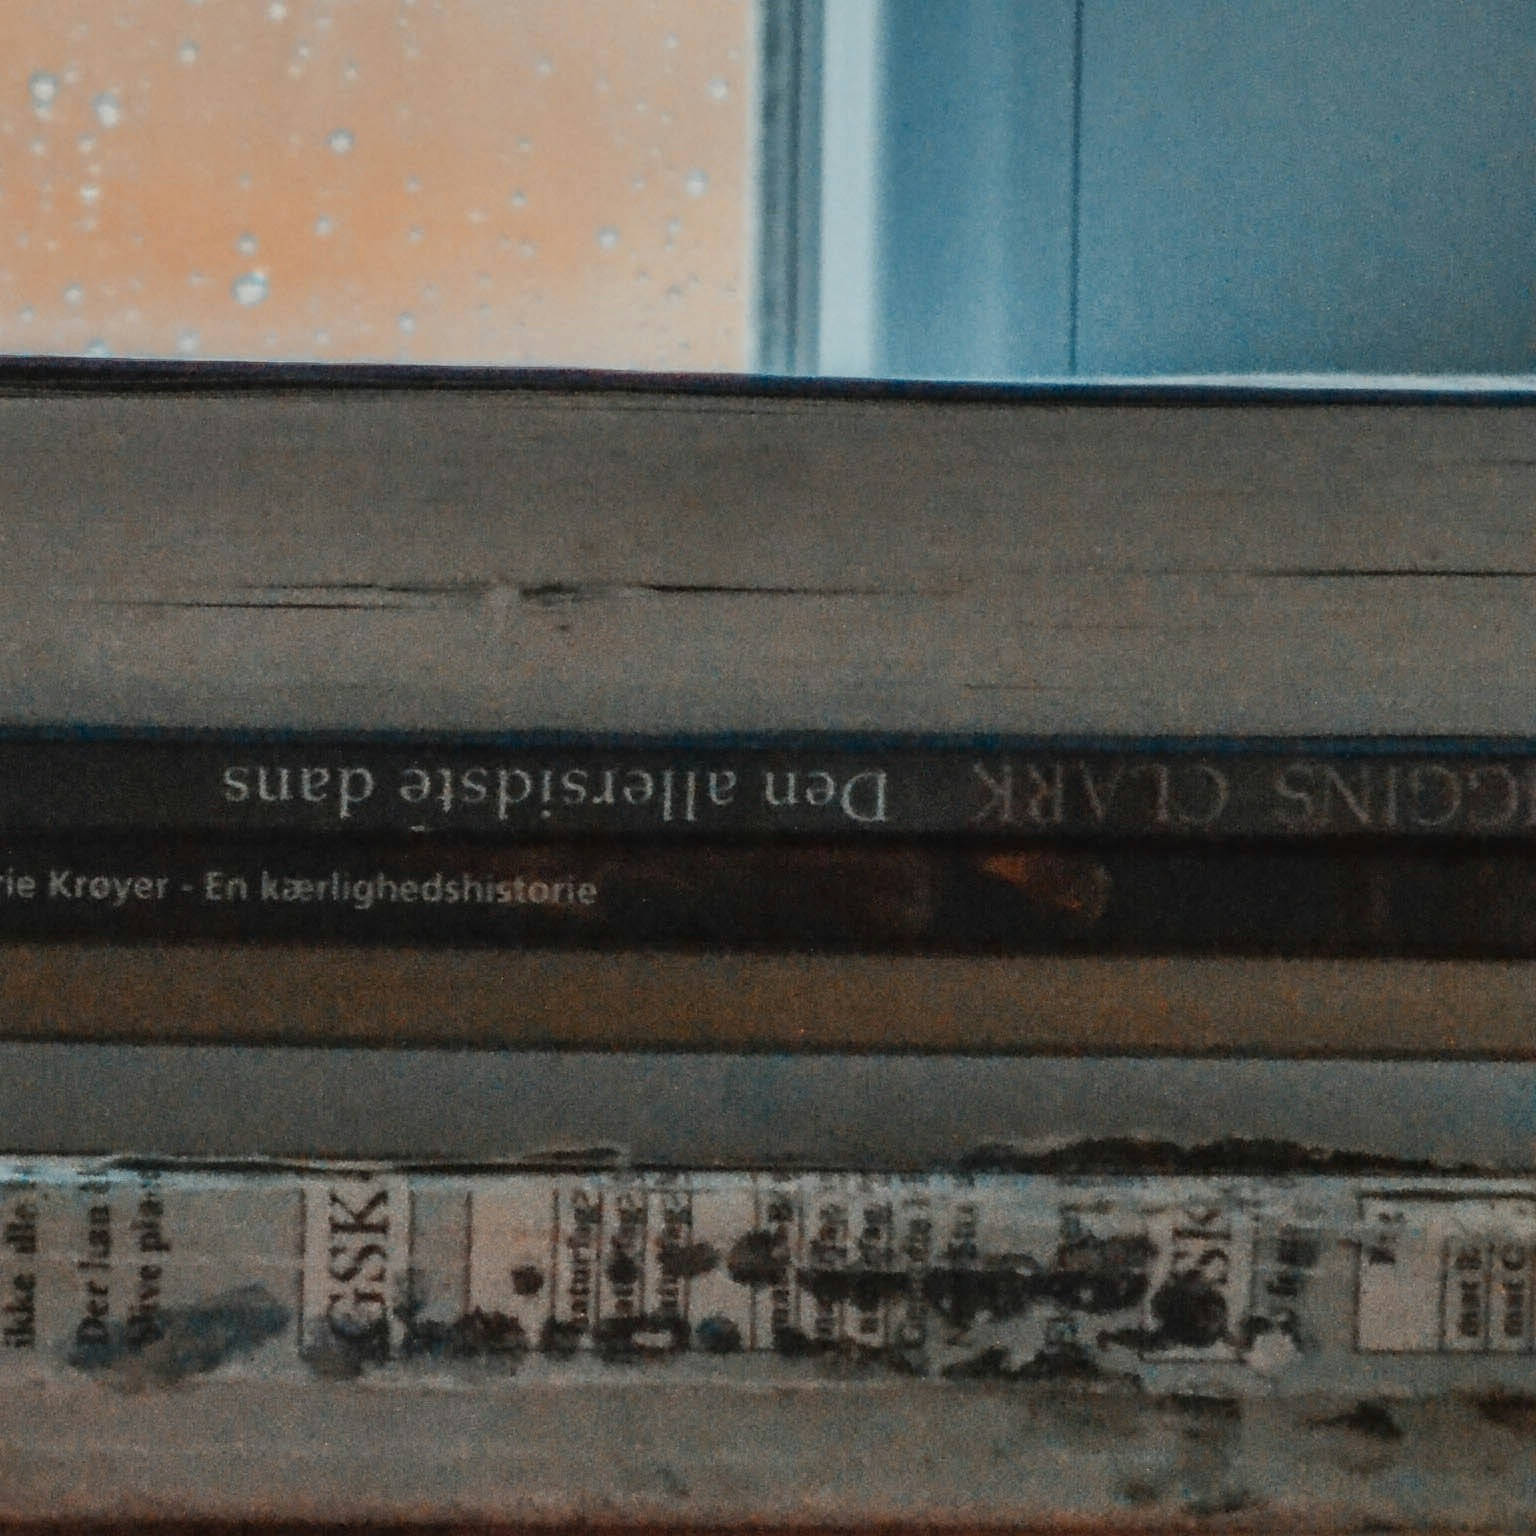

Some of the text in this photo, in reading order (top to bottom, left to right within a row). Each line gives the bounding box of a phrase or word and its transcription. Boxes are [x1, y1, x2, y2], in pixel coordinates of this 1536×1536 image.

[221, 764, 889, 823] Den allersidste dans
[974, 764, 1231, 826] CLARK
[48, 869, 170, 908] Krøyer
[204, 871, 249, 902] En
[261, 871, 600, 911] kærlighedshistorie
[327, 1186, 390, 1340] GSK
